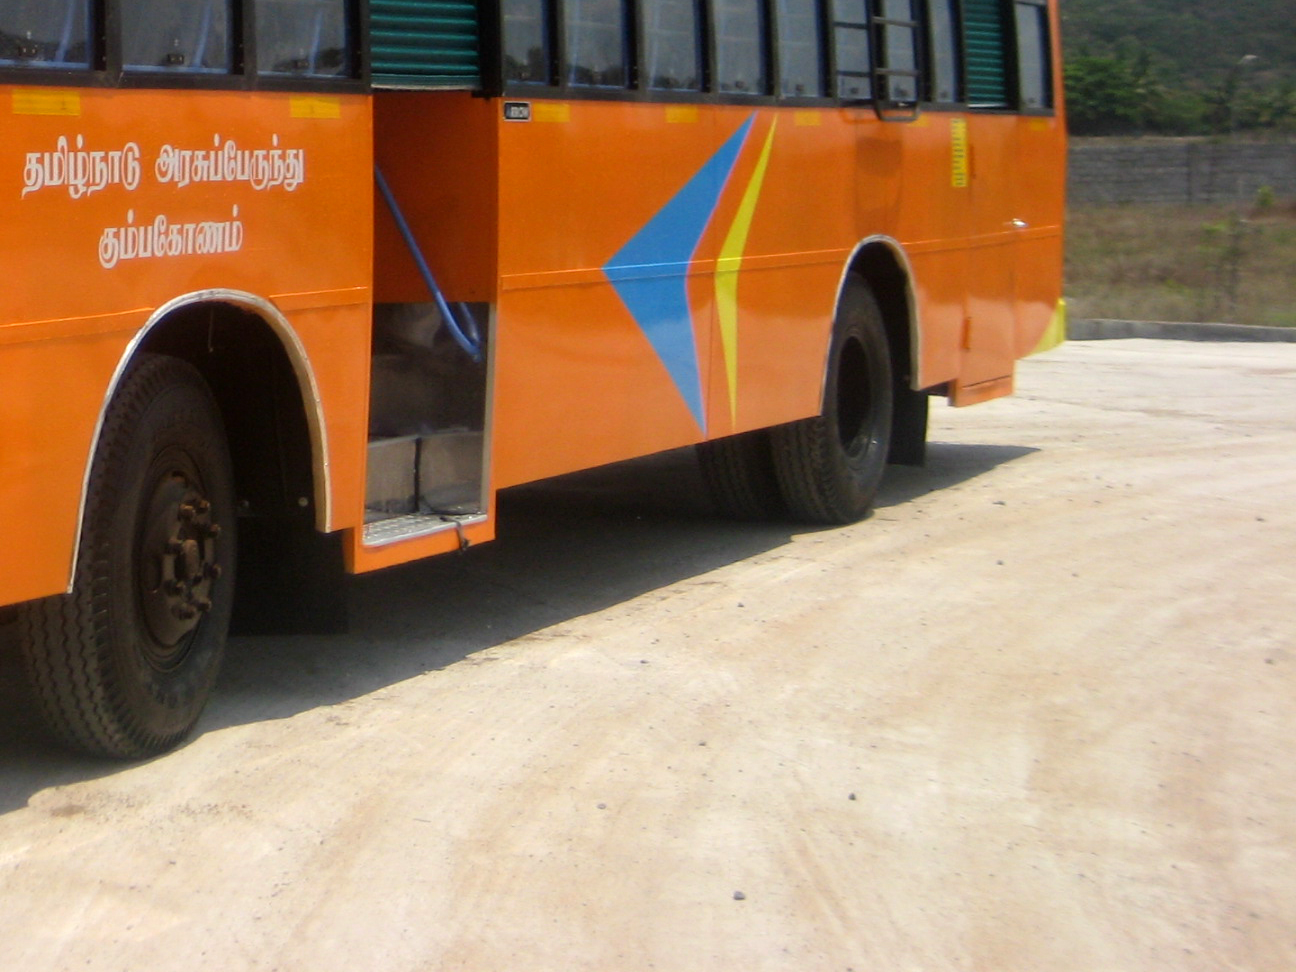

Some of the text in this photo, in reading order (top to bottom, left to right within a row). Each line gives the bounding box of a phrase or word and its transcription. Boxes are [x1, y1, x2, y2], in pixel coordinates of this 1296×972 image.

[21, 133, 304, 200] தமிழ்நாடு அரசுப்பேருந்து
[98, 204, 244, 269] கும்பகோணம்
